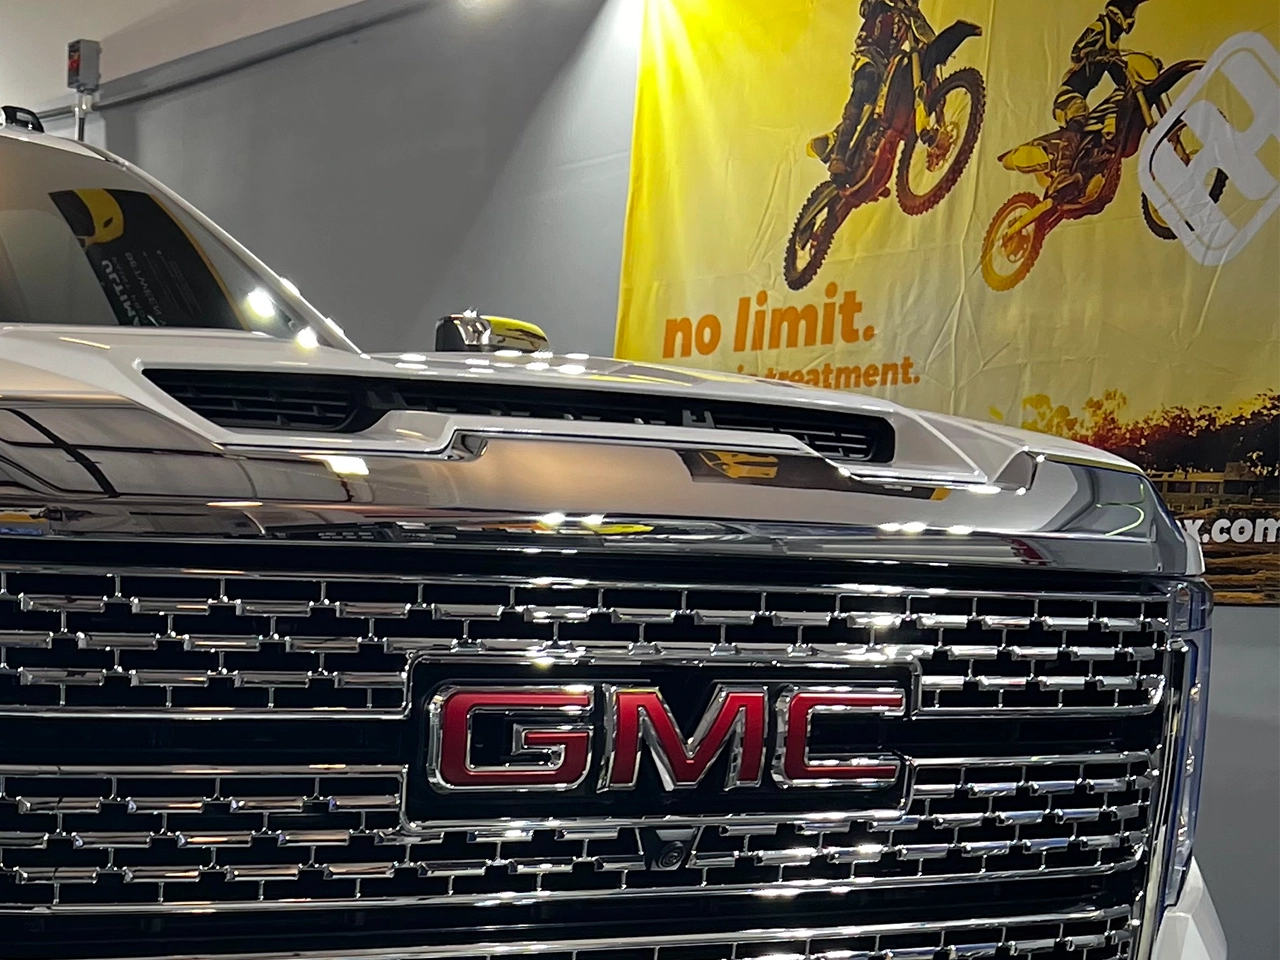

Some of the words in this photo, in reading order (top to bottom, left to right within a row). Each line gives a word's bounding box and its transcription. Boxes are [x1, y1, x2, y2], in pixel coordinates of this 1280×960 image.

[662, 313, 721, 359] no
[733, 281, 875, 352] limit.
[426, 684, 906, 793] GMC
